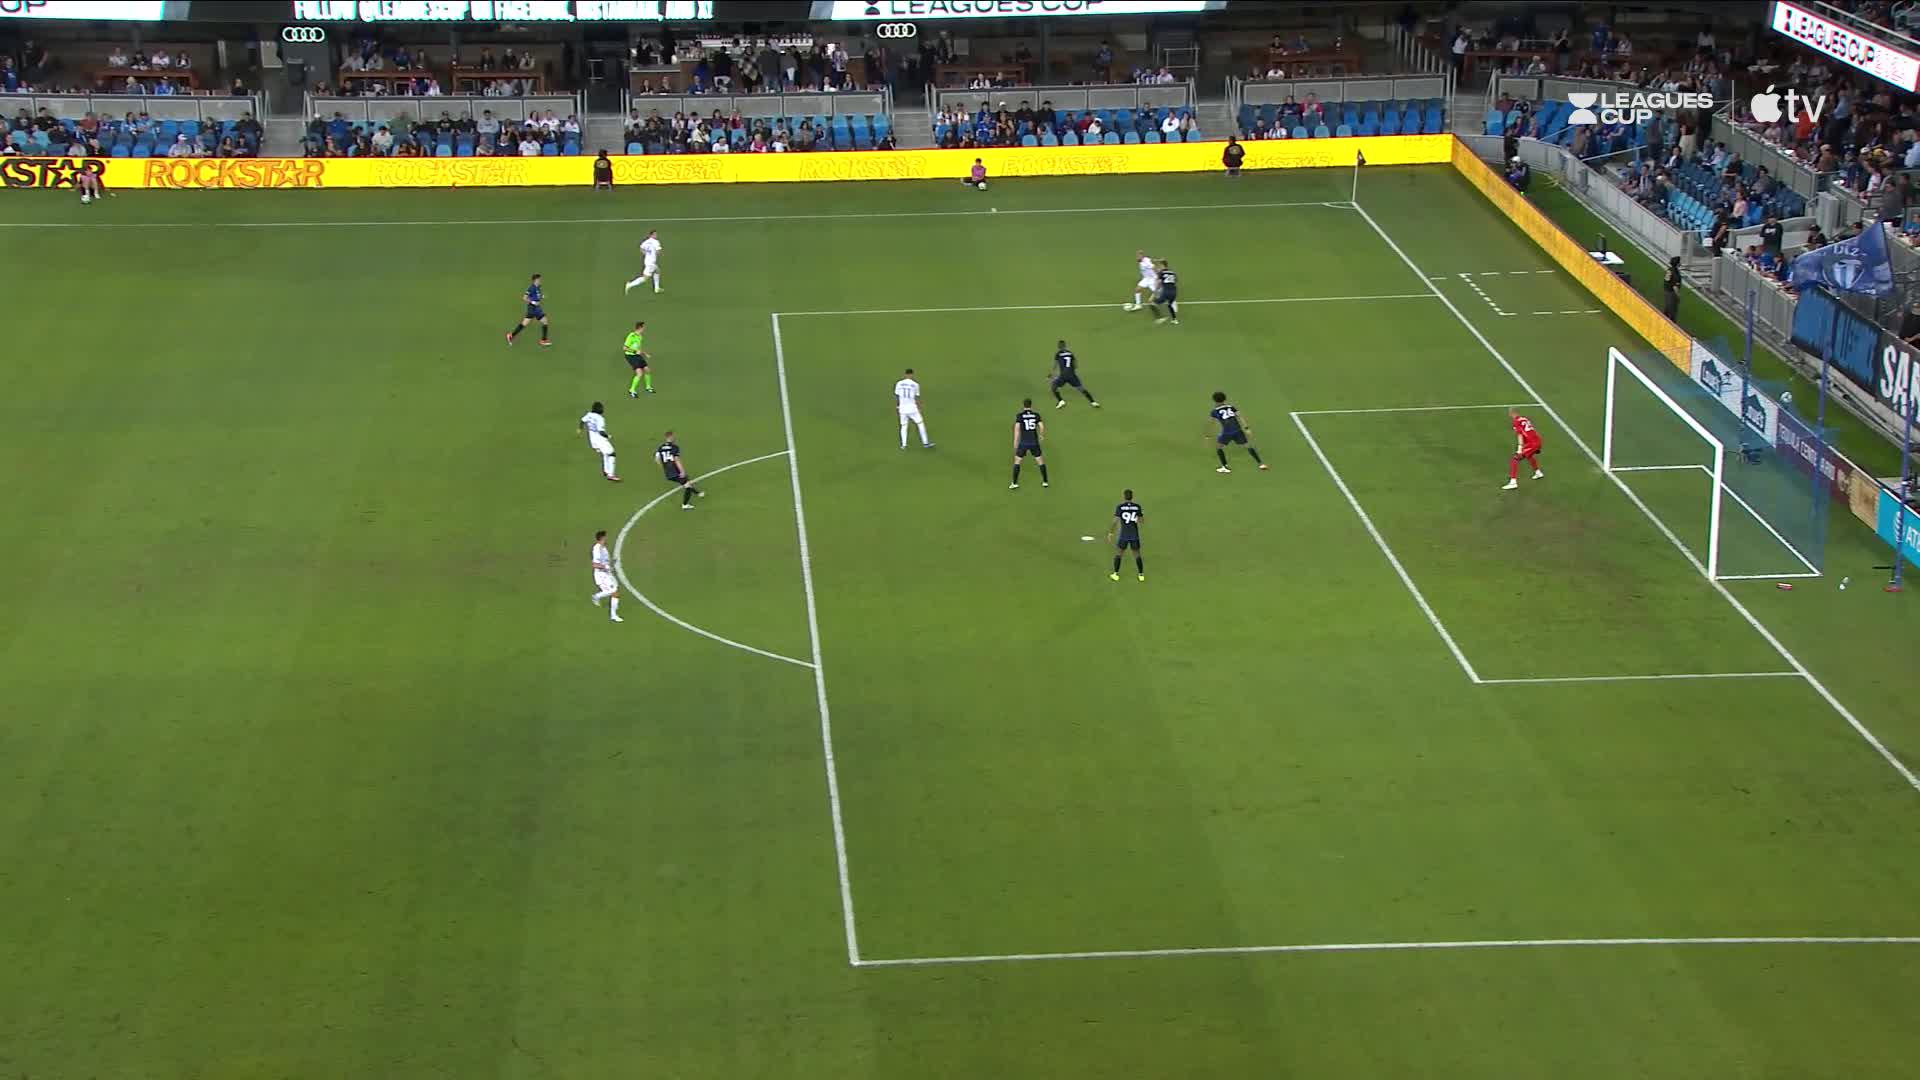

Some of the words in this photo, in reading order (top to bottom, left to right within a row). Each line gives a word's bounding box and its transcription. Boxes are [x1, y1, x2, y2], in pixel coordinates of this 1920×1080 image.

[1794, 15, 1847, 57] LEAGUES
[1848, 39, 1875, 65] CUP
[143, 159, 325, 187] ROCKSTAR
[610, 159, 723, 182] OCKSTAR
[1063, 356, 1071, 368] 7
[1218, 407, 1235, 420] 26
[1023, 418, 1036, 431] 15
[1121, 511, 1138, 524] 94
